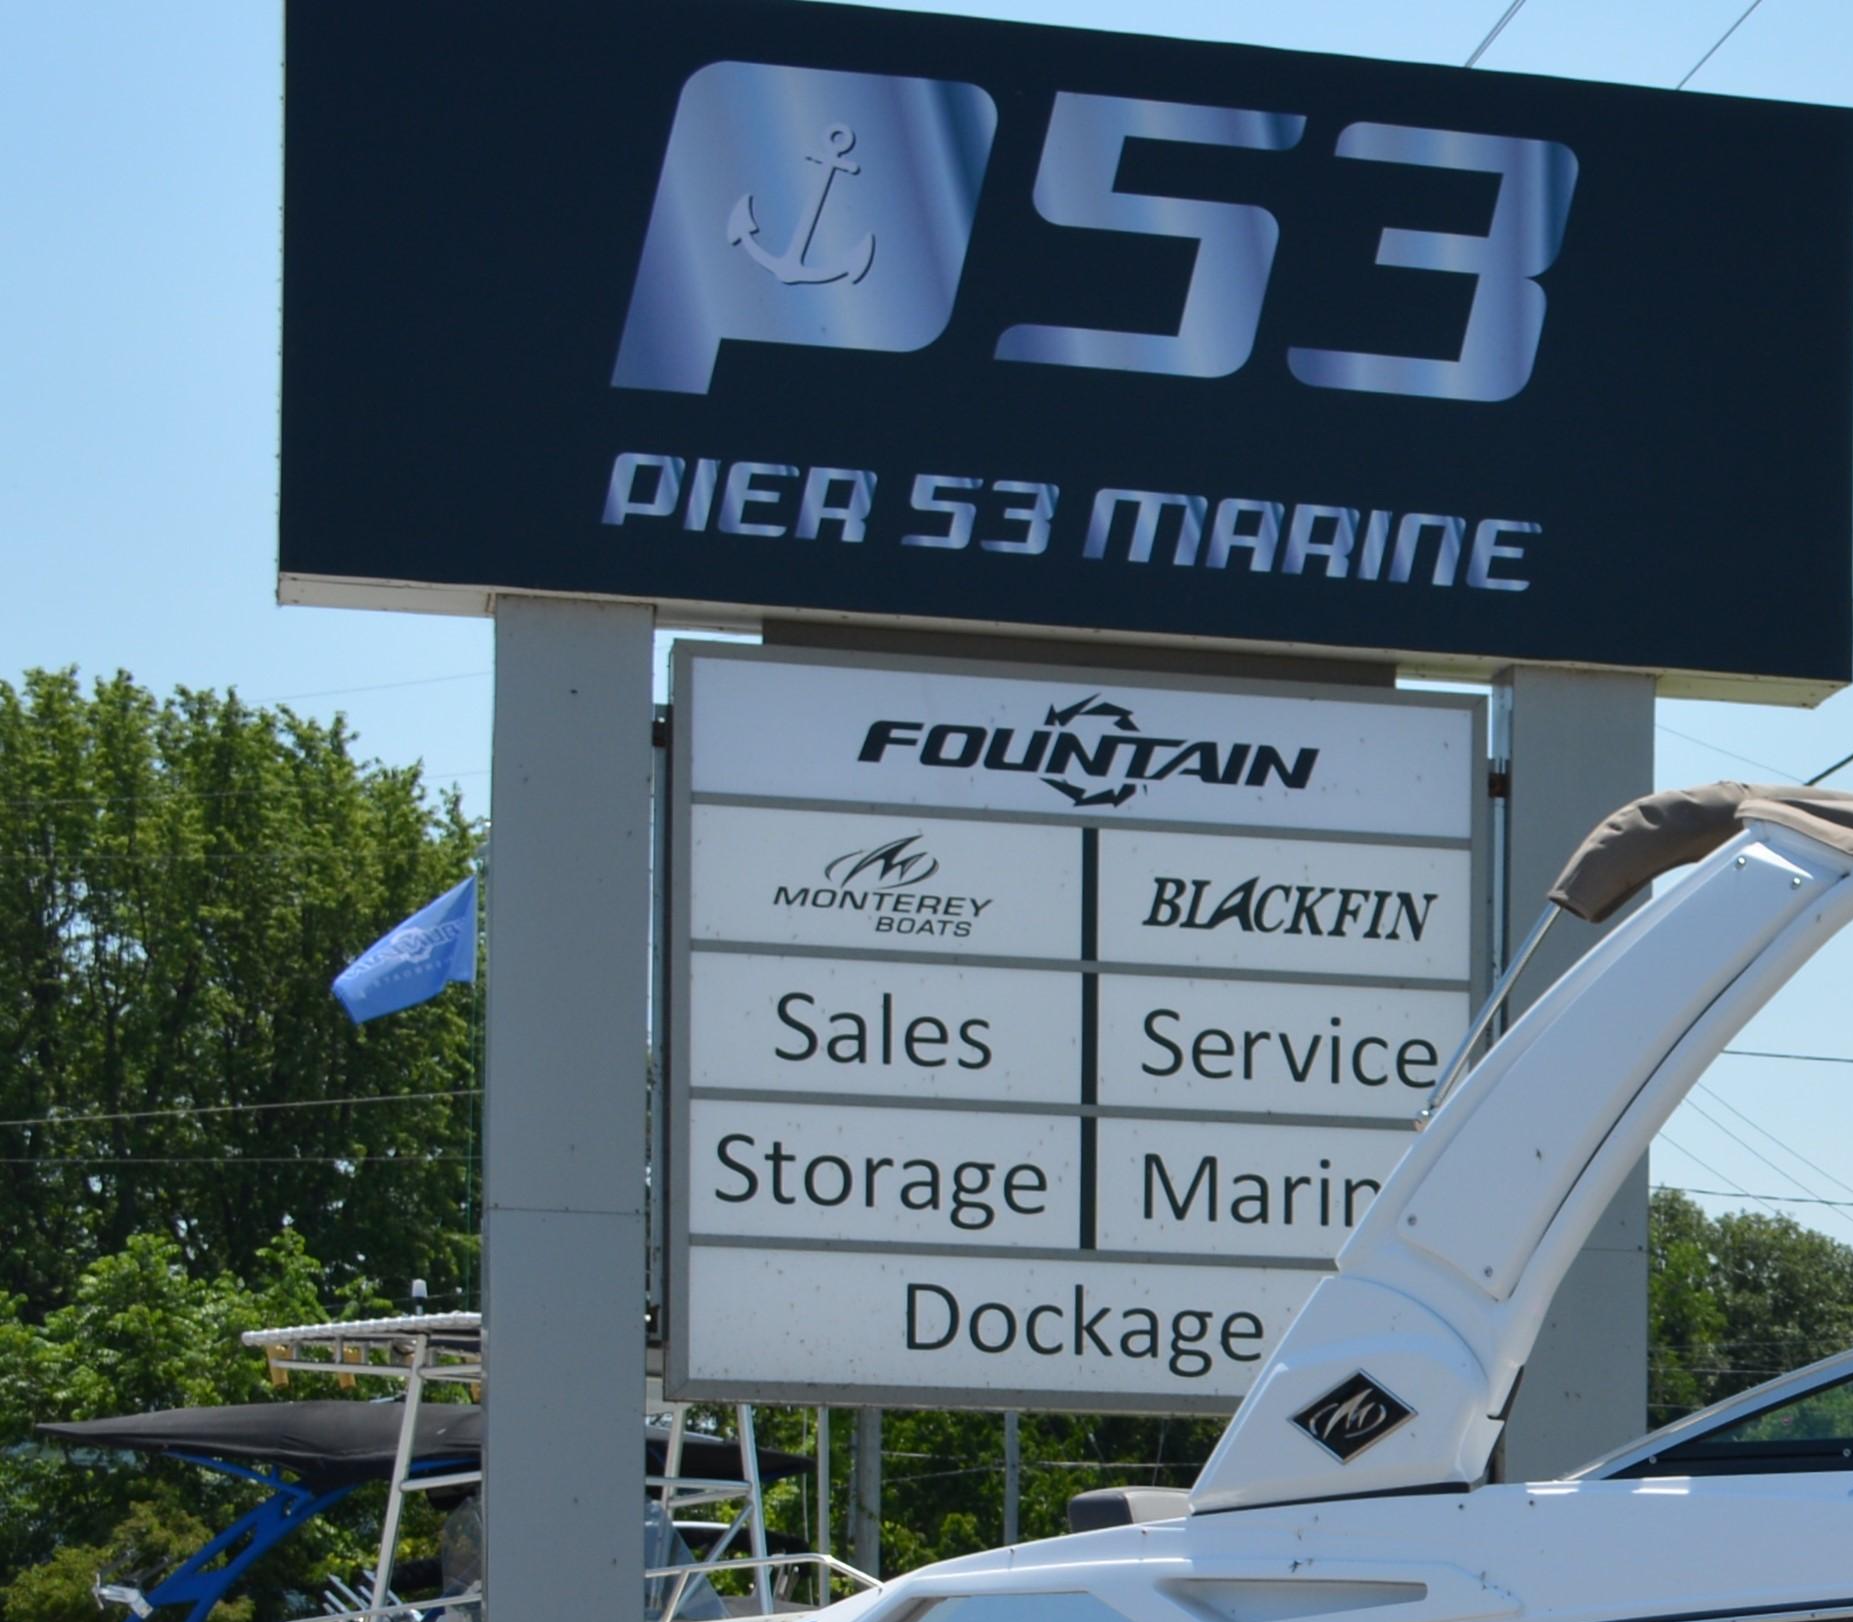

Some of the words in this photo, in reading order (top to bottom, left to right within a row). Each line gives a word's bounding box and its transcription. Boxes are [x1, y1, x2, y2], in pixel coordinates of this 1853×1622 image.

[600, 452, 878, 543] PIER
[900, 473, 1060, 556] 53
[1081, 487, 1543, 592] MARINE
[857, 719, 1320, 789] FOUNTAIN
[773, 886, 994, 918] MONTEREY
[875, 915, 973, 938] BOATS
[1141, 874, 1439, 942] BLACKFIN
[773, 991, 993, 1070] Sales
[1141, 1008, 1439, 1089] Service
[714, 1133, 1049, 1231] Storage
[1143, 1153, 1382, 1228] Marin
[906, 1283, 1264, 1378] Dockage
